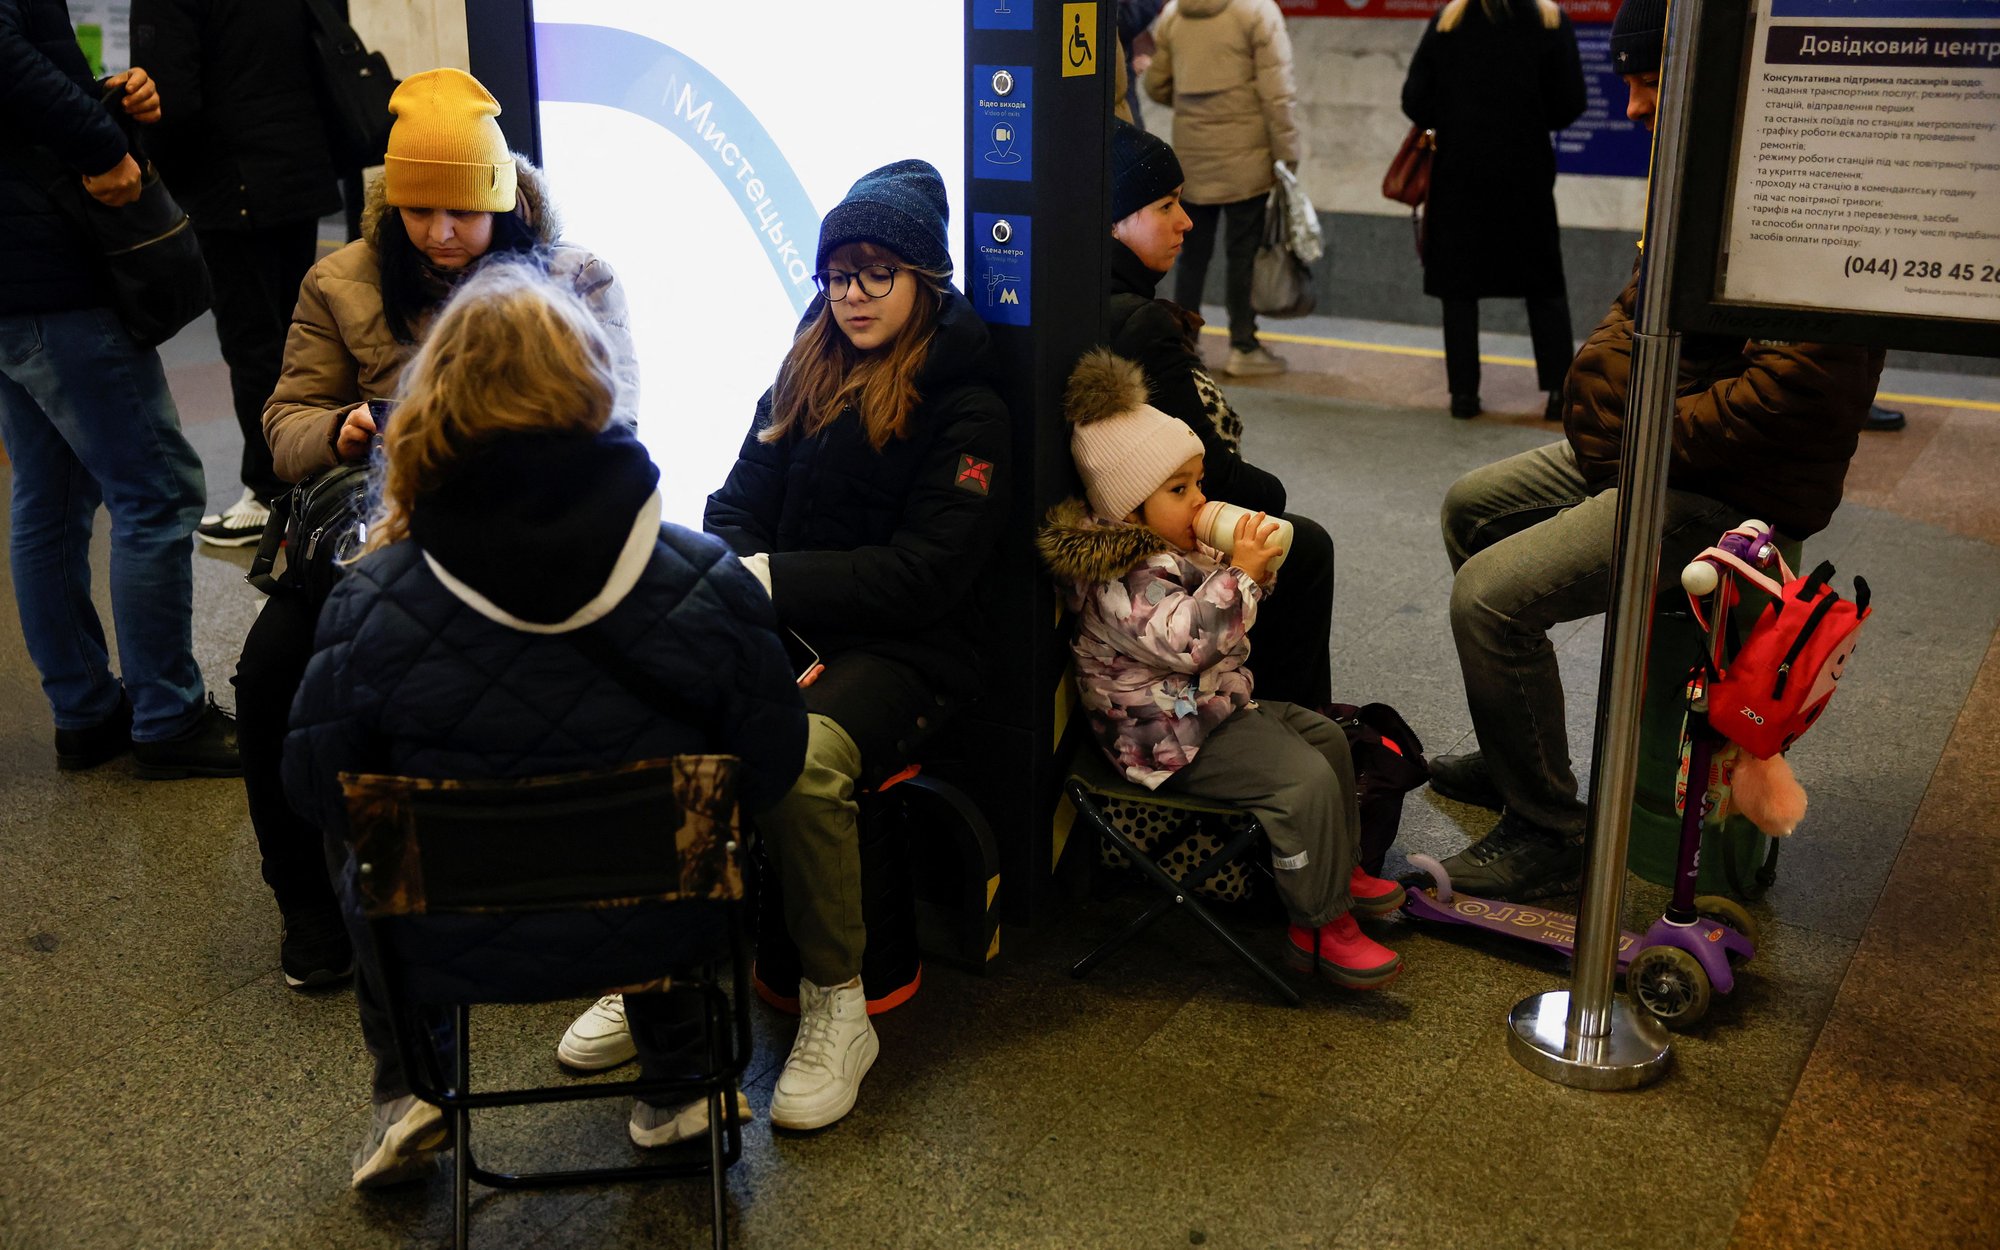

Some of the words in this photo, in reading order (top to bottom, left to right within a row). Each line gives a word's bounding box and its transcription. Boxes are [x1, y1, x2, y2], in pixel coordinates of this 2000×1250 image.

[1800, 35, 1929, 56] Довідковий
[1934, 40, 2000, 61] центр
[1763, 73, 1841, 84] Консультативна
[1843, 75, 1894, 86] підтримка
[1896, 76, 1949, 88] пасажирів
[1951, 78, 1984, 88] щодо:
[1767, 86, 1808, 95] надання
[1810, 87, 1880, 98] транспортних
[1921, 91, 1961, 101] режиму
[979, 99, 999, 109] Відео
[1000, 101, 1026, 109] виходів
[1807, 101, 1873, 111] відправлення
[1875, 104, 1915, 114] перших
[1764, 115, 1774, 123] та
[1776, 115, 1818, 124] останніх
[1821, 117, 1854, 126] поїздів
[1871, 119, 1914, 128] станціях
[1762, 127, 1799, 137] графіку
[1801, 128, 1837, 138] роботи
[1839, 130, 1898, 141] ескалаторів
[1901, 132, 1911, 140] та
[1913, 133, 1976, 142] проведення
[1758, 153, 1796, 163] режиму
[1798, 153, 1835, 164] роботи
[1837, 156, 1874, 166] станцій
[1876, 158, 1891, 167] під
[1894, 159, 1909, 167] час
[1912, 159, 1967, 170] повітряної
[1758, 167, 1767, 175] та
[1769, 168, 1807, 178] укриття
[1809, 170, 1863, 180] населення;
[673, 82, 811, 285] Мистецька
[1755, 180, 1797, 190] проходу
[1812, 182, 1852, 192] станцію
[1861, 185, 1937, 196] комендантську
[1940, 188, 1976, 198] годину
[1753, 192, 1768, 201] під
[1770, 194, 1786, 202] час
[1788, 195, 1840, 206] повітряної
[1842, 198, 1884, 208] тривоги;
[1752, 204, 1789, 214] тарифів
[1804, 208, 1844, 218] послуги
[1922, 213, 1959, 223] засоби
[1762, 219, 1804, 229] способи
[1805, 222, 1840, 231] оплати
[1884, 227, 1891, 236] у
[1893, 227, 1918, 237] тому
[1919, 229, 1946, 238] числі
[1749, 232, 1783, 242] засобів
[1785, 235, 1819, 244] оплати
[980, 245, 1002, 254] Схема
[1003, 249, 1024, 258] метро
[1844, 255, 1898, 281] (044)
[1903, 260, 1942, 279] 238
[1948, 263, 1975, 281] 45
